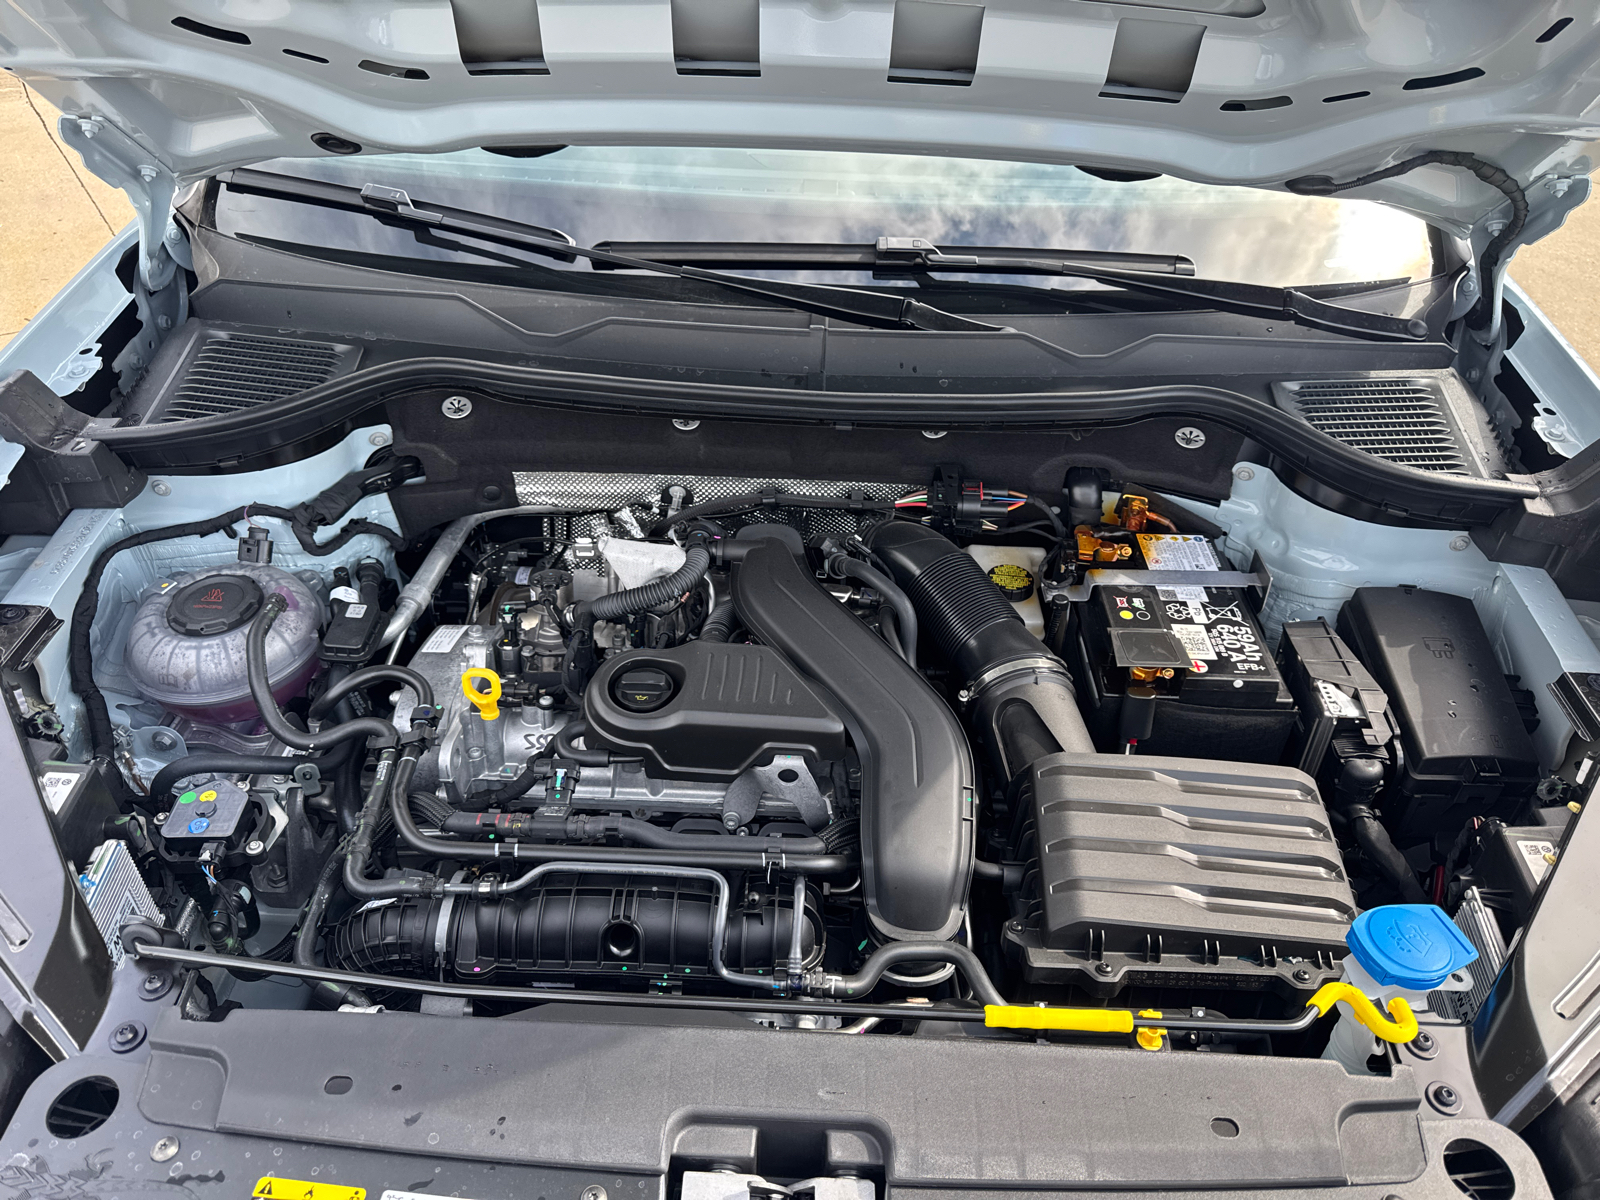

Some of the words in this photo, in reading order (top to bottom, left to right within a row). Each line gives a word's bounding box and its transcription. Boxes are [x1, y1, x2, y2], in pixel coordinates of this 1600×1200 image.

[1191, 606, 1202, 617] Pb
[1216, 624, 1242, 649] 640
[1233, 626, 1263, 661] 59Ah
[1227, 651, 1247, 662] A
[1236, 662, 1267, 671] EFB+
